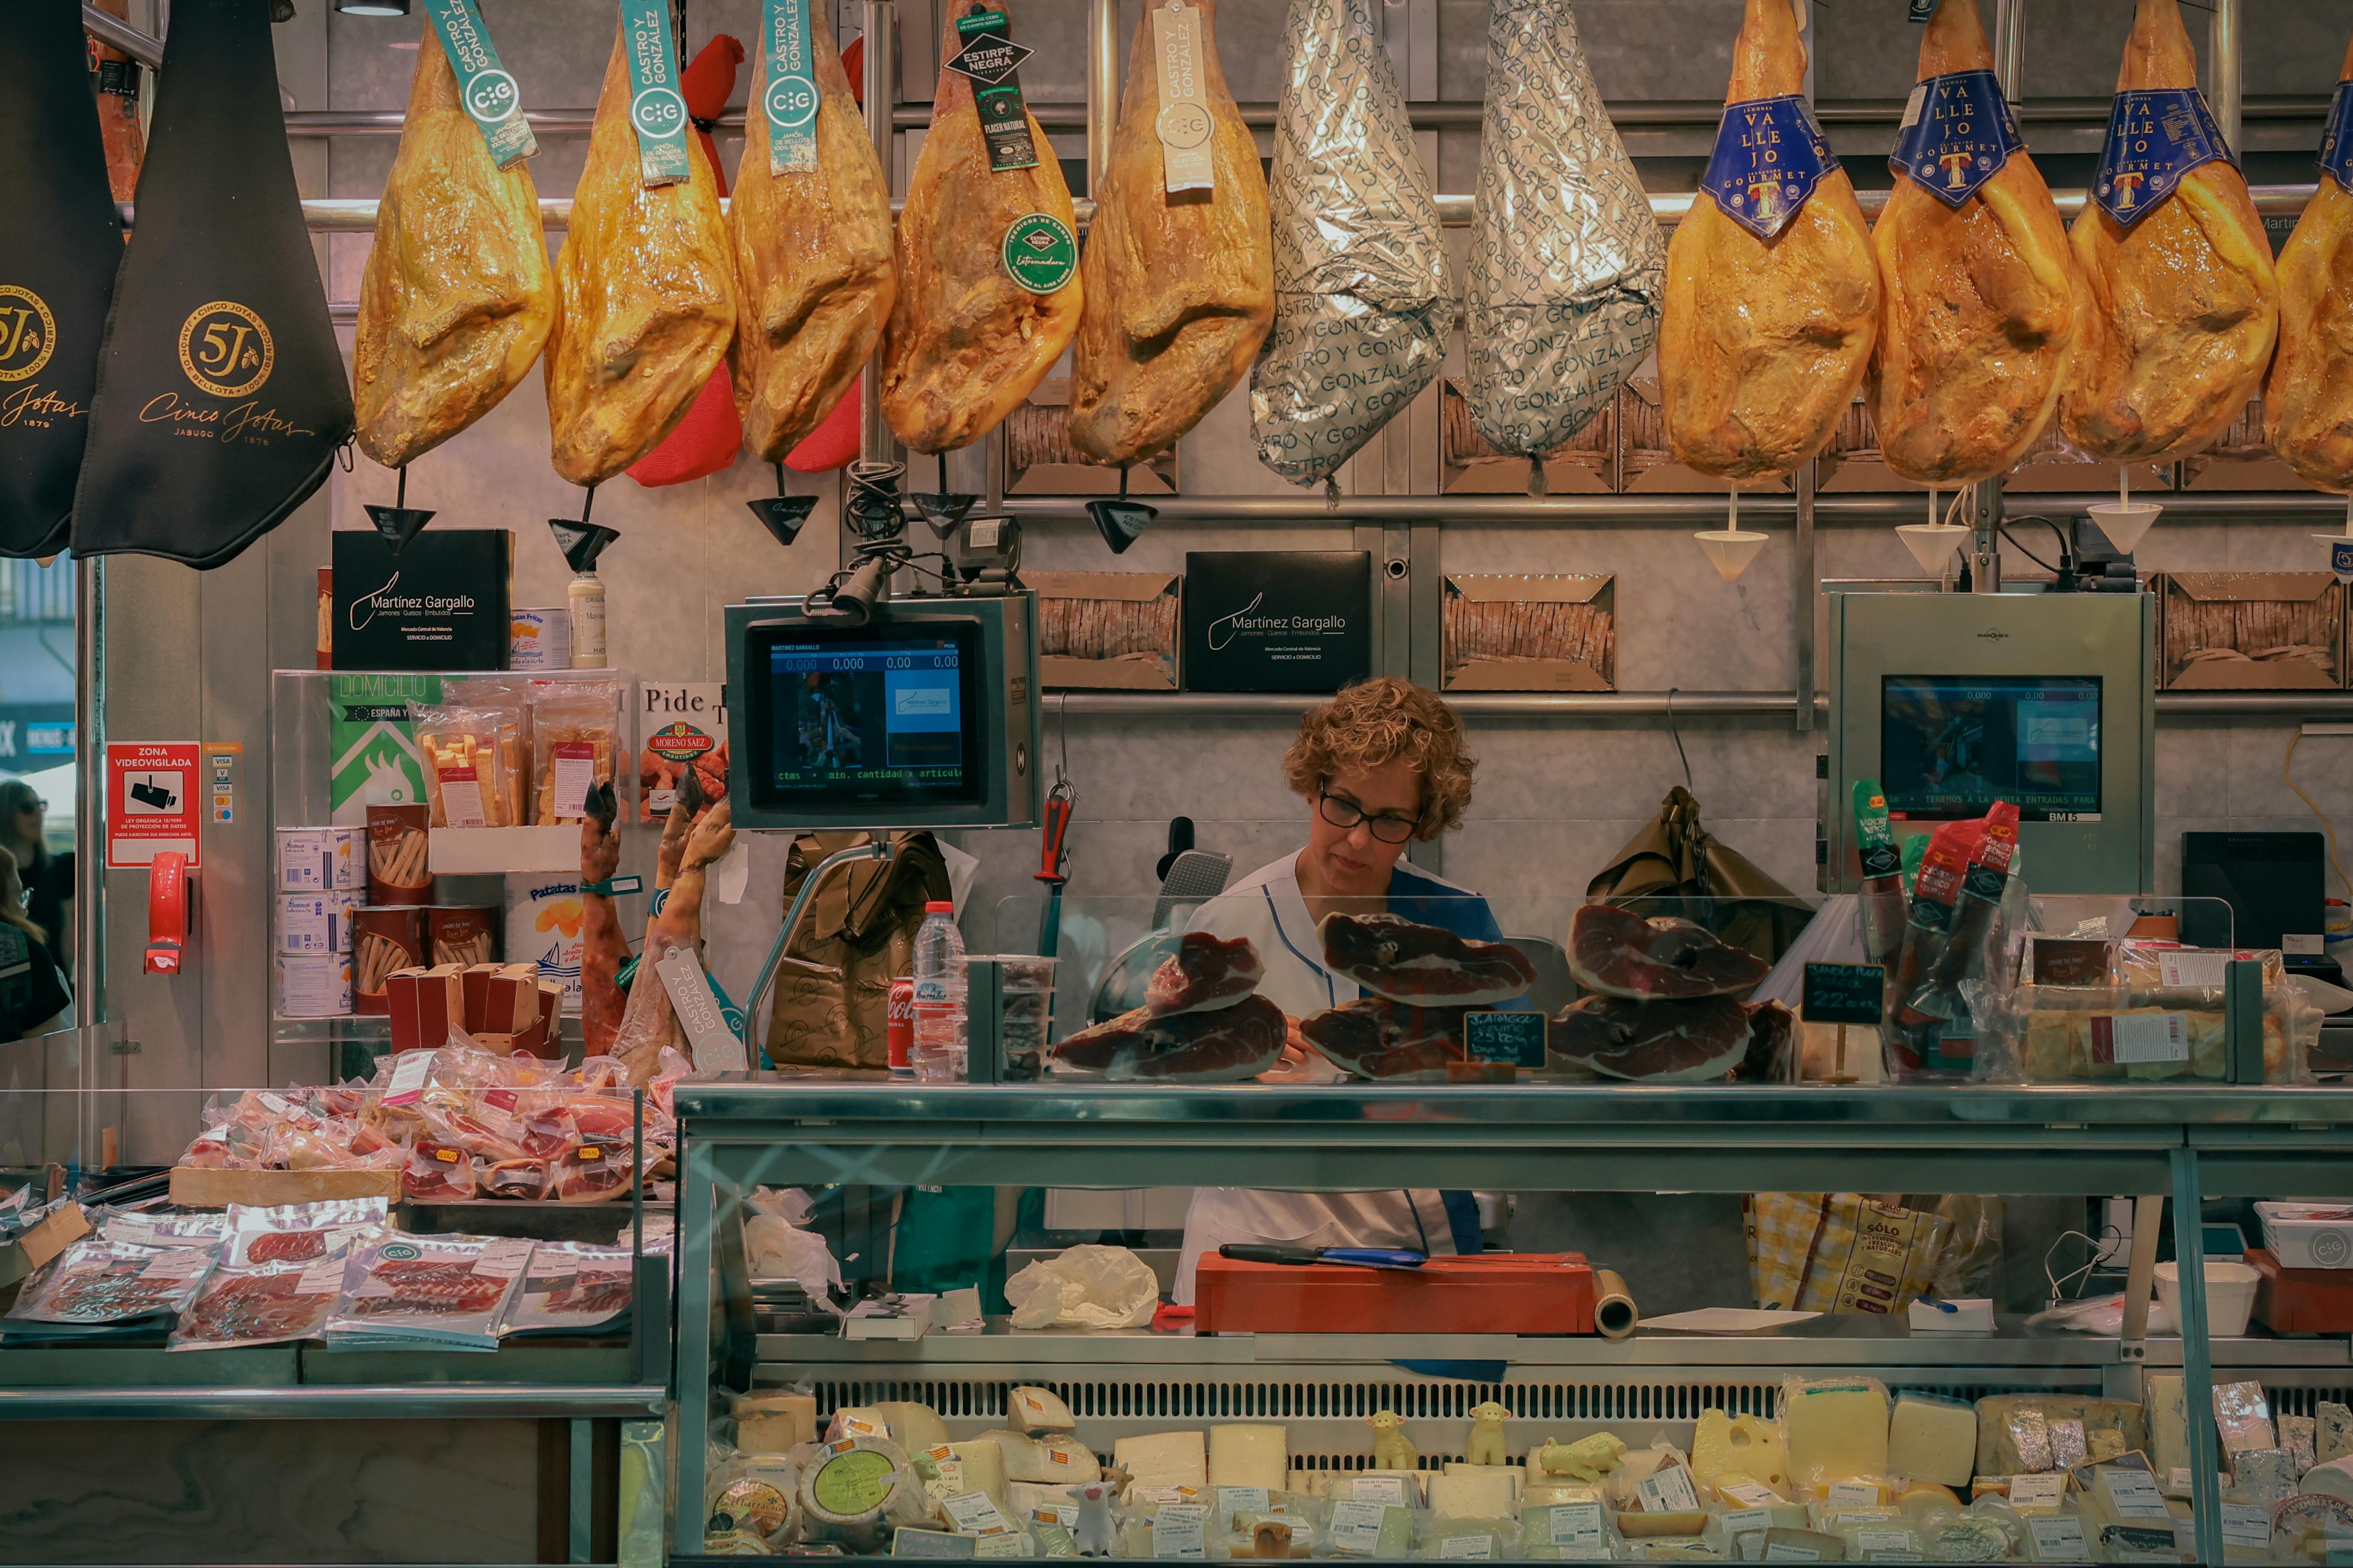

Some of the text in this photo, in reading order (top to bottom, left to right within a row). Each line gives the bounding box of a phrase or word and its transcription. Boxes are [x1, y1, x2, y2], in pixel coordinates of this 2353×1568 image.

[440, 9, 476, 73] CASTRO Y
[774, 5, 788, 73] CASTRO Y
[634, 18, 653, 85] CASTRO Y
[963, 46, 1014, 63] ESTIRPE
[968, 56, 1012, 71] NEGRA
[1165, 30, 1181, 98] CASTRO Y
[985, 119, 1026, 134] PLACER NATURAL
[1917, 144, 1998, 159] GOURMET
[1724, 171, 1805, 188] GOURMET
[1052, 222, 1071, 245] CAMPO
[1011, 266, 1033, 286] CRIADOS
[1057, 267, 1070, 283] LIBRE
[13, 287, 40, 306] JOTAS
[198, 303, 258, 323] CINCO JOTAS
[198, 322, 252, 377] 5J
[183, 359, 193, 374] DE
[193, 373, 235, 395] BELLOTA
[1, 383, 90, 427] Jotas
[139, 392, 315, 442] Cinco Jotas
[174, 428, 214, 438] JABUGO
[371, 595, 475, 610] Martínez Gargallo
[1232, 615, 1346, 631] Martínez Gargallo
[833, 658, 864, 669] 0,000
[887, 657, 910, 669] 0,00
[934, 656, 958, 668] 0,00
[340, 675, 426, 697] DOMICILIO
[645, 689, 704, 712] Pide
[2026, 692, 2044, 700] 0,00
[371, 708, 401, 717] ESPAÑA
[655, 738, 705, 747] MORENO SAEZ
[858, 769, 902, 779] cantidad
[2049, 813, 2066, 822] BM
[530, 883, 577, 901] Patatas
[672, 976, 705, 1033] CASTRO Y
[1867, 1222, 1900, 1236] SÓLO
[1866, 1244, 1902, 1257] NATURALES
